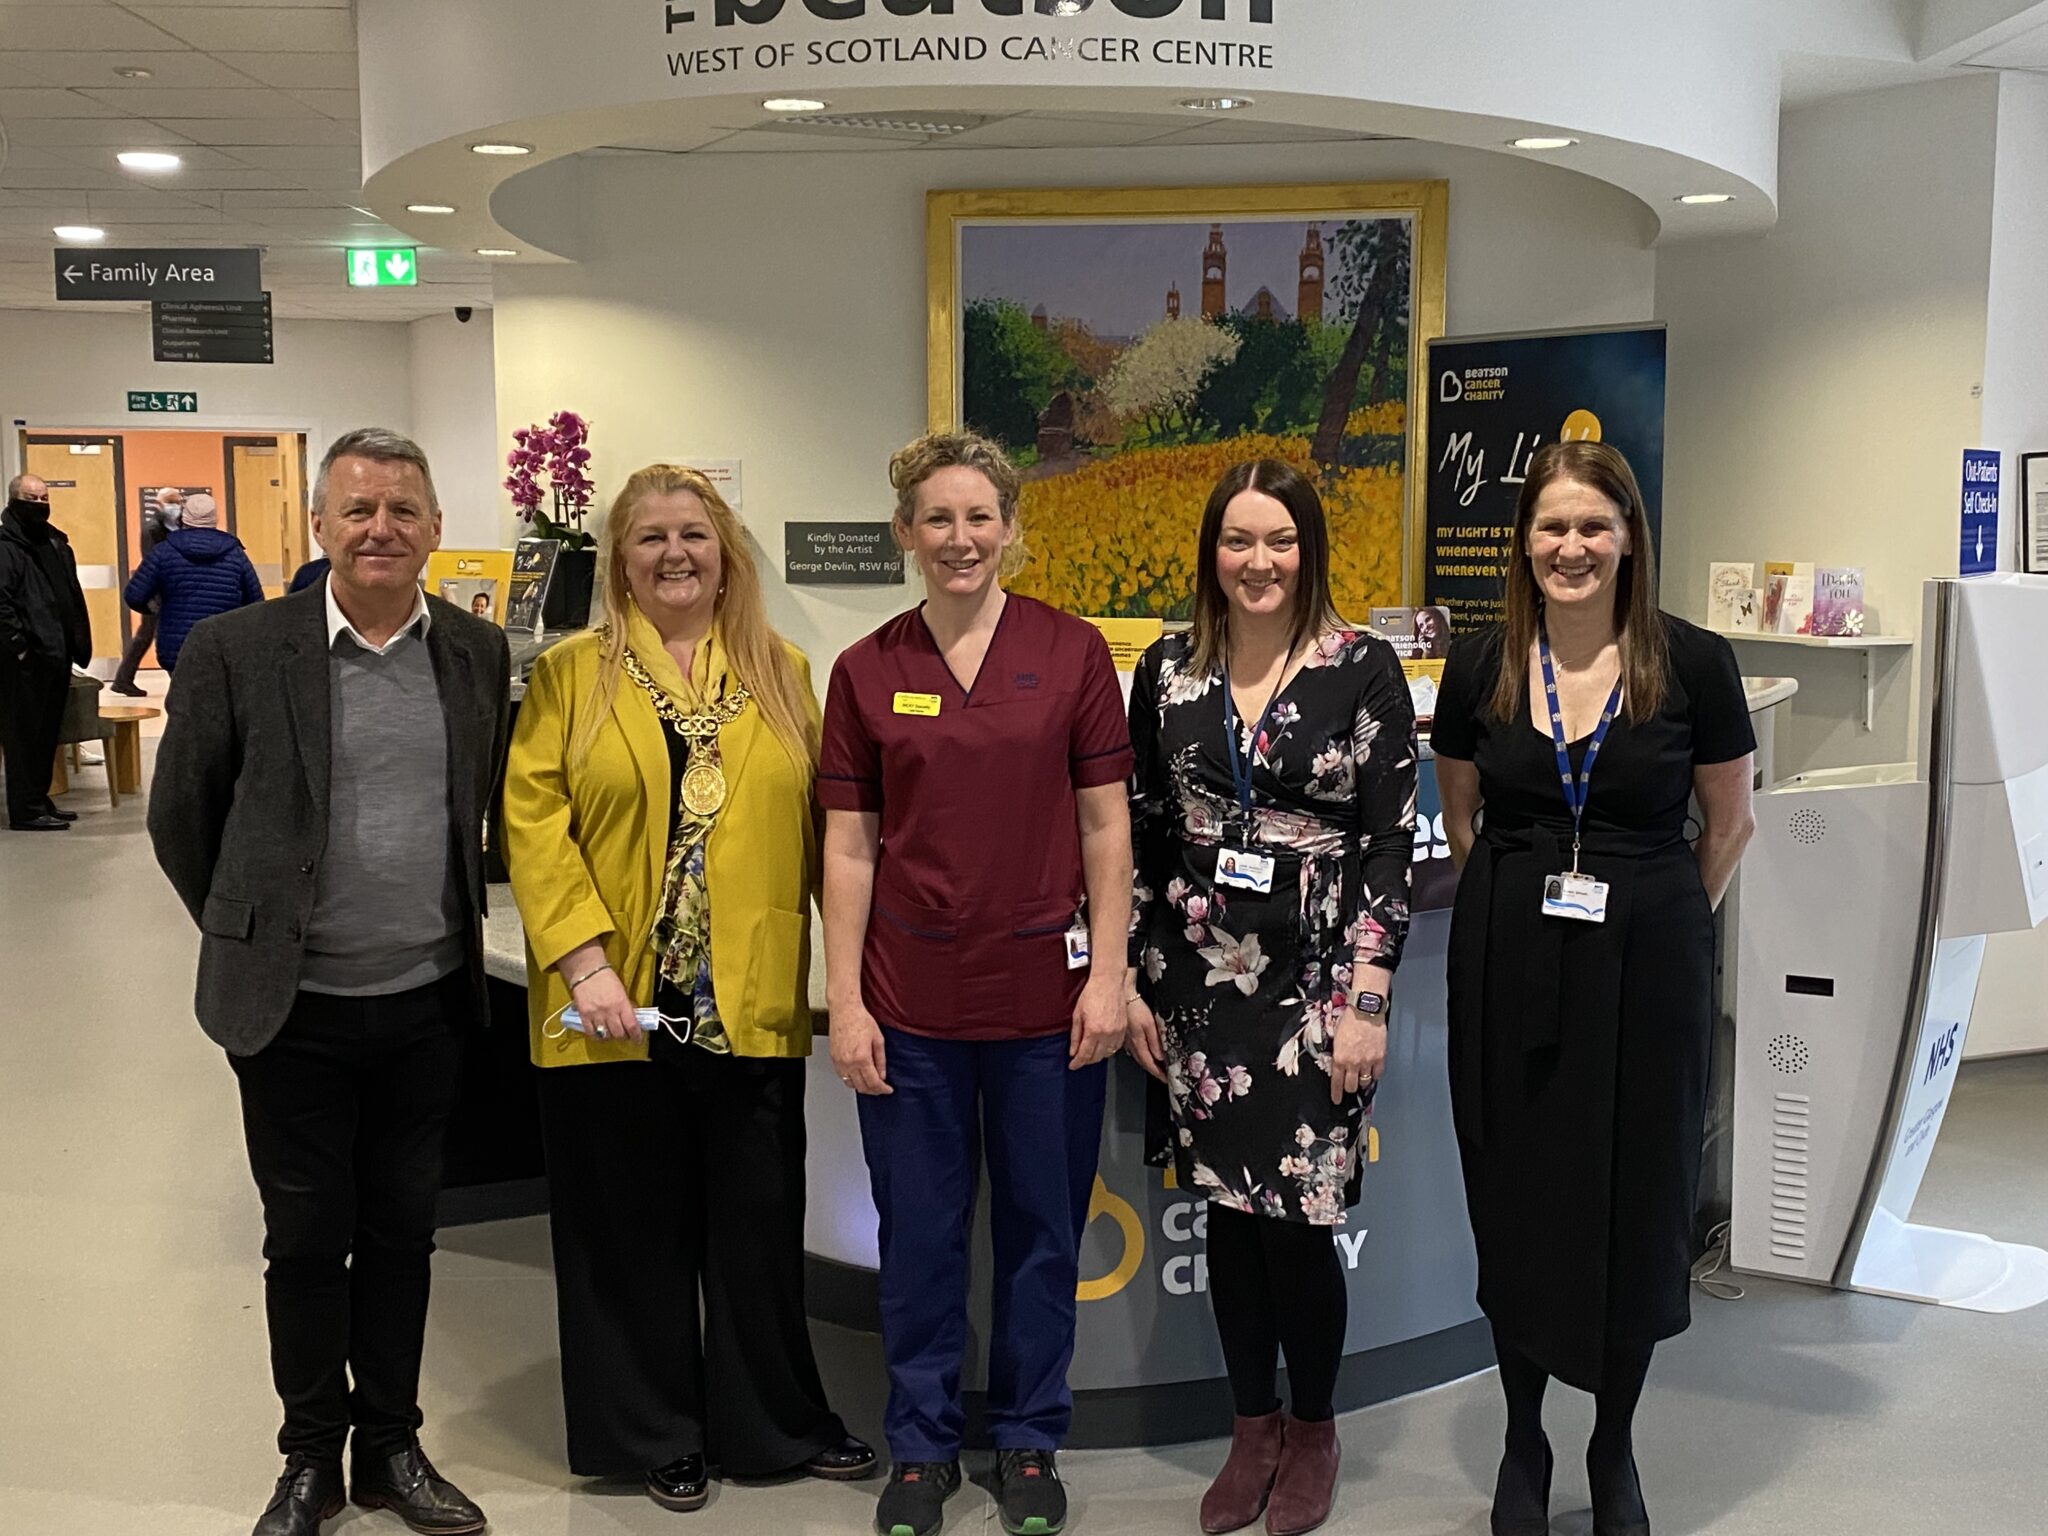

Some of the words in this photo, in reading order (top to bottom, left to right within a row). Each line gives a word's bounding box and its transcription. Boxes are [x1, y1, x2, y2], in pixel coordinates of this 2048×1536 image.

[666, 46, 744, 76] WEST
[754, 42, 795, 69] OF
[807, 36, 988, 65] SCOTLAND
[1000, 36, 1140, 63] CANCER
[1152, 40, 1273, 69] CENTRE
[90, 262, 158, 286] Family
[165, 263, 215, 282] Area
[1438, 431, 1488, 507] My
[1965, 460, 1998, 482] Out-Patients
[1963, 491, 1975, 514] Self
[807, 533, 836, 544] Kindly
[838, 533, 880, 543] Donated
[1456, 527, 1488, 538] LIGHT
[1490, 527, 1501, 538] IS
[814, 544, 826, 555] by
[828, 545, 844, 554] the
[846, 545, 873, 554] Artist
[789, 561, 822, 573] George
[824, 561, 857, 572] Devlin,
[859, 562, 881, 571] RSW
[1923, 1022, 1959, 1086] NHS
